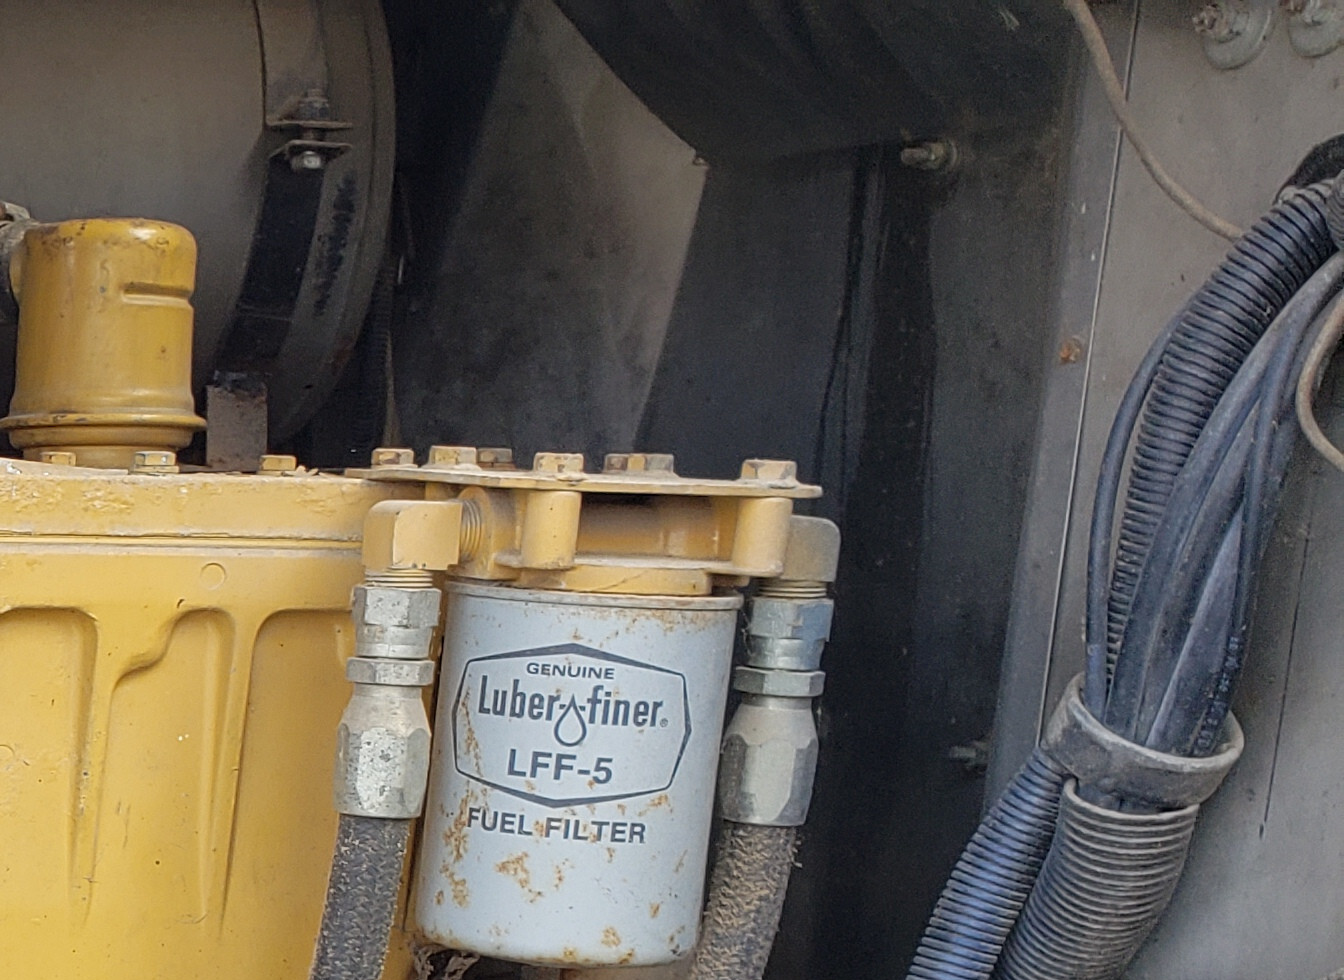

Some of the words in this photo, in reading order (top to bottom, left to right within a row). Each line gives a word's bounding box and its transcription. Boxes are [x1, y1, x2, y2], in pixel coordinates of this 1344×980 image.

[526, 662, 615, 680] GENUINE
[507, 748, 613, 784] LFF-5
[466, 807, 533, 836] FUEL
[544, 817, 646, 844] FILTER
